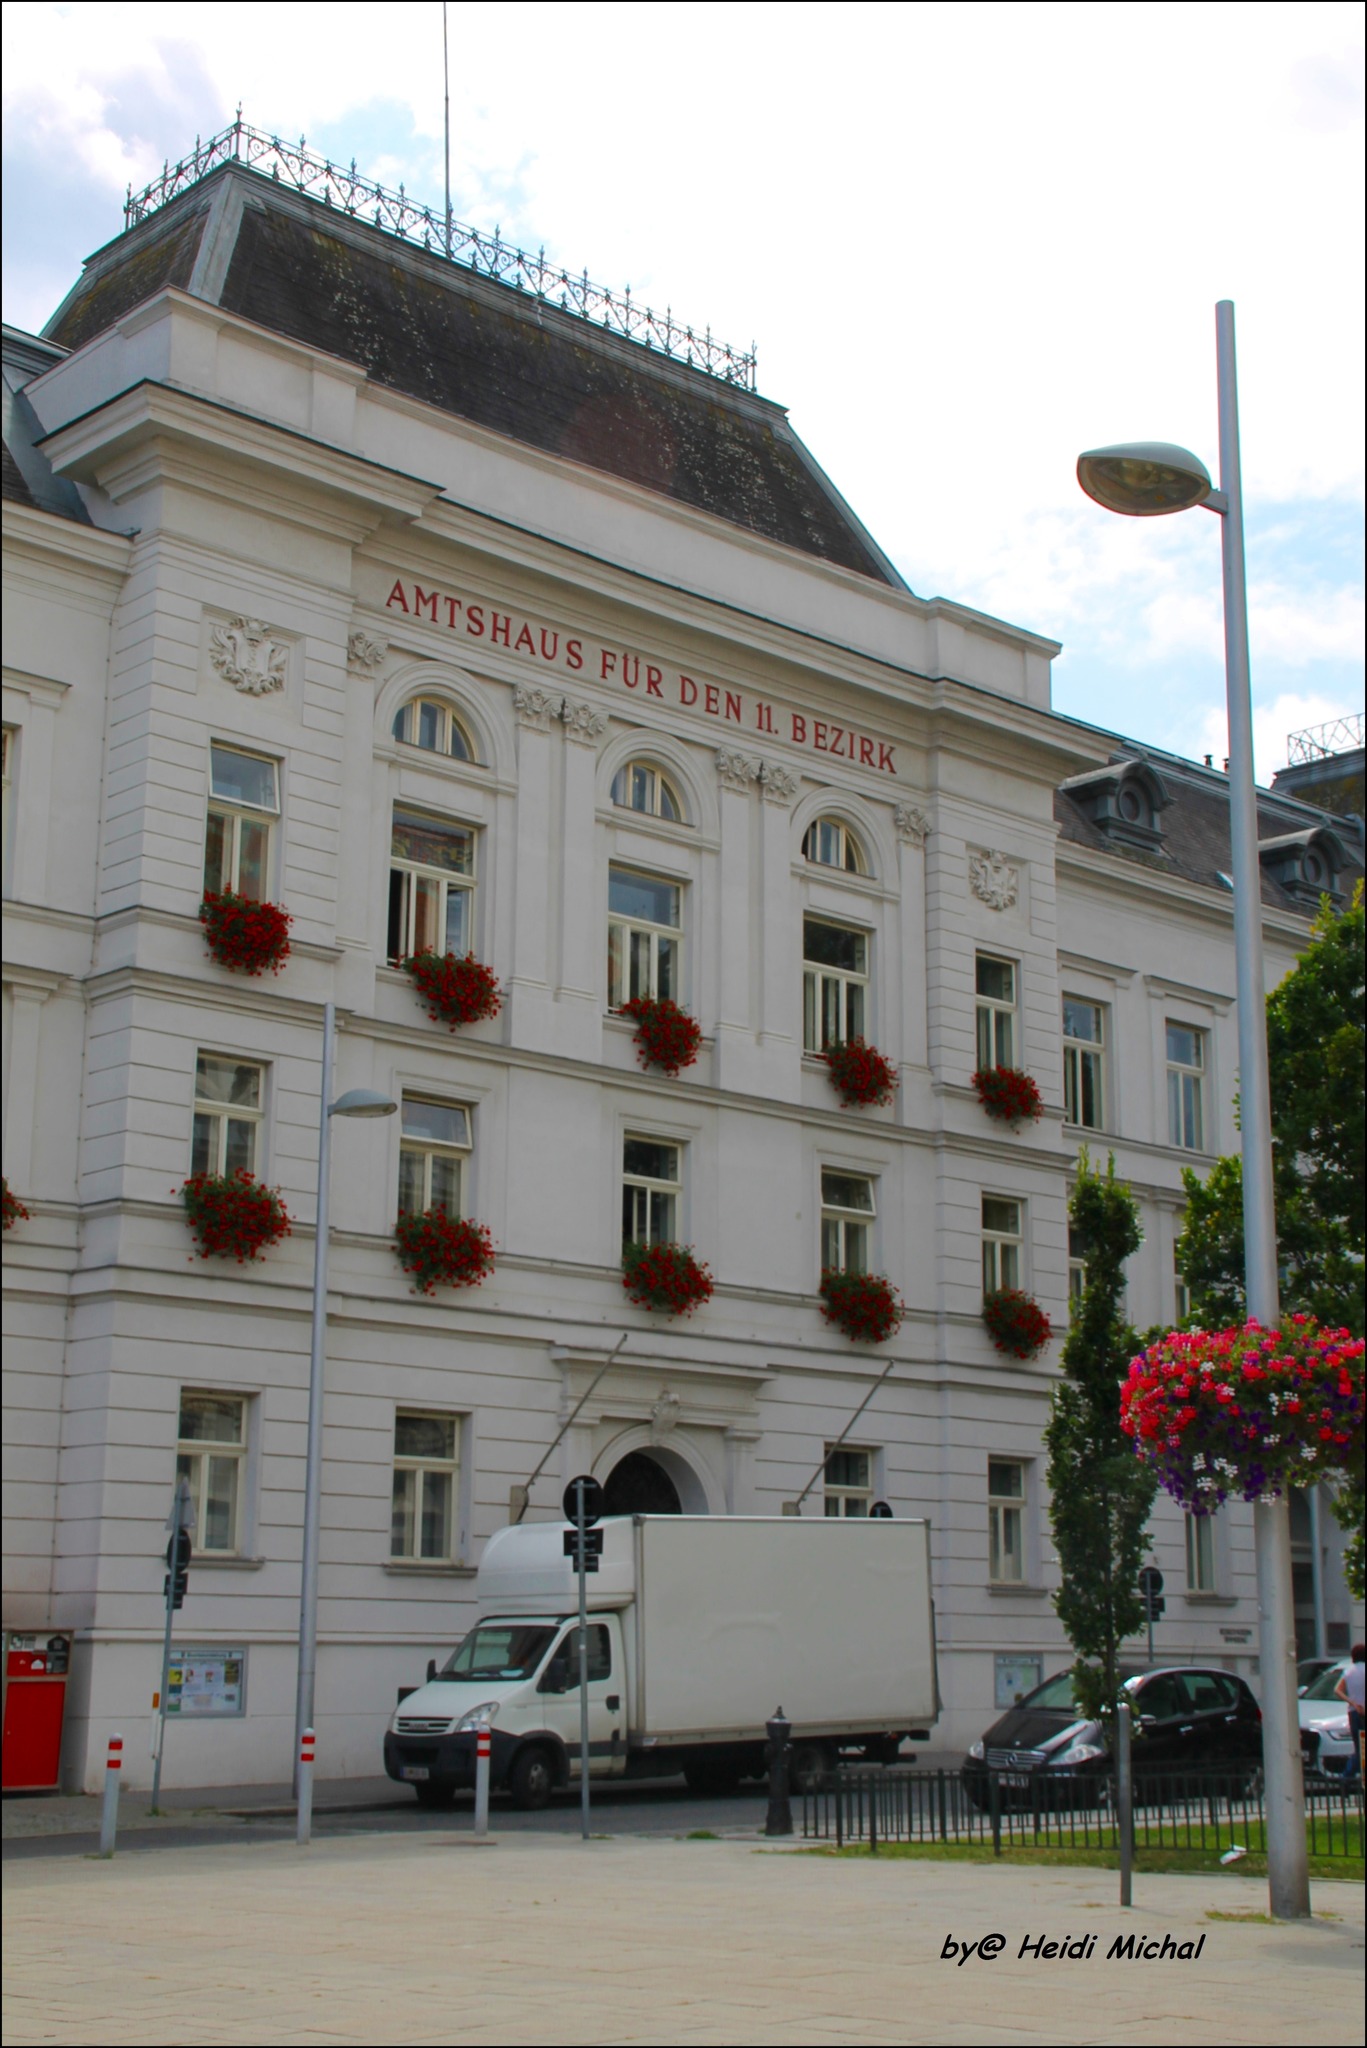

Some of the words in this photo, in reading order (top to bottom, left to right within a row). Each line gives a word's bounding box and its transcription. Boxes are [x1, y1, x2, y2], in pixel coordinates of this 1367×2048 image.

[385, 578, 584, 670] AMTSHAUS
[600, 649, 664, 698] FÜR
[679, 674, 742, 723] DEN
[755, 701, 779, 735] 11.
[791, 713, 897, 774] BEZIRK
